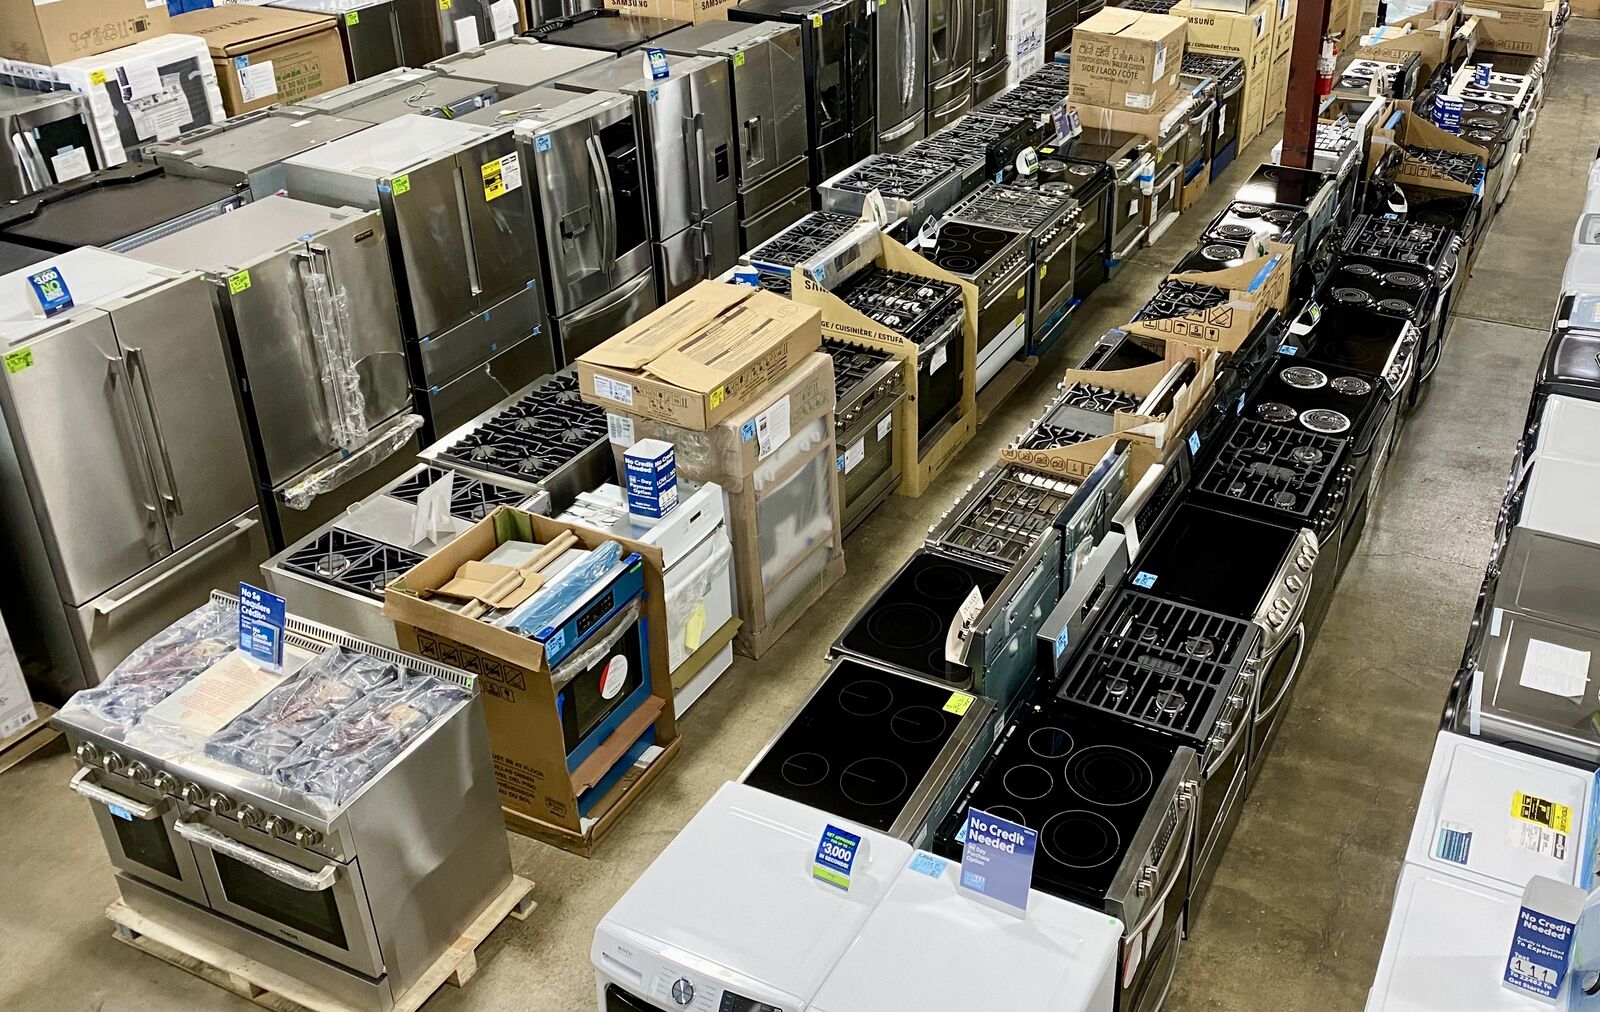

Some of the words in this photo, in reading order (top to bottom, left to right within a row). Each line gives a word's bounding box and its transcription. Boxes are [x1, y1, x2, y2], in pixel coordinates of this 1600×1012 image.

[1082, 64, 1096, 74] SIDE
[1100, 68, 1117, 77] LADO
[1122, 69, 1139, 80] CÔTÉ
[41, 280, 60, 294] NO
[836, 324, 872, 337] CUISINIÈRE
[878, 332, 904, 344] ESTUFA
[628, 464, 652, 474] Needed
[634, 460, 654, 468] Credit
[241, 588, 252, 598] No
[252, 592, 261, 602] Se
[241, 596, 271, 614] Requiere
[241, 606, 266, 620] Crédito
[970, 816, 988, 832] No
[989, 824, 1025, 846] Credit
[968, 828, 1016, 854] Needed
[822, 841, 852, 862] $3,000
[1521, 911, 1536, 923] No
[1538, 918, 1572, 935] Credit
[1523, 920, 1566, 941] Needed
[1514, 952, 1530, 961] Text
[1516, 940, 1526, 948] To
[1527, 944, 1564, 962] Experian
[1508, 977, 1522, 986] Get
[1522, 982, 1550, 996] Started
